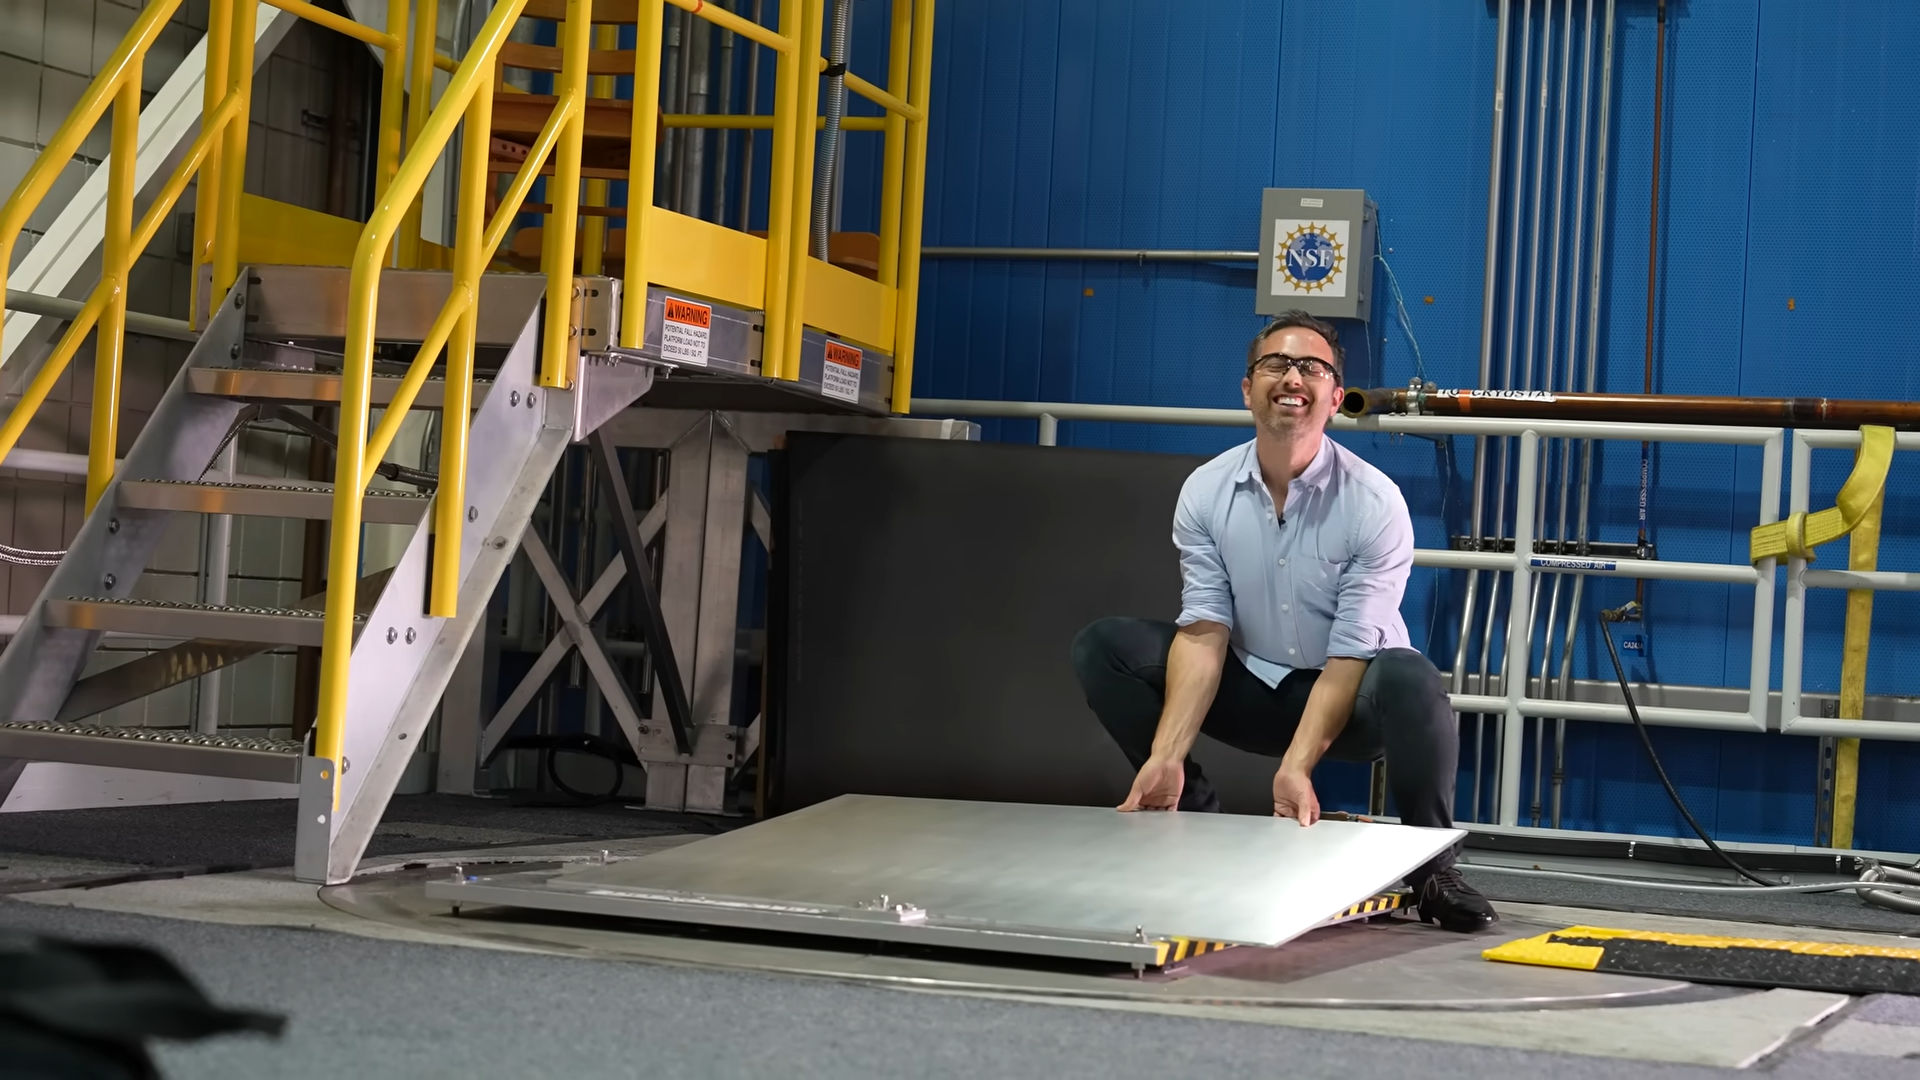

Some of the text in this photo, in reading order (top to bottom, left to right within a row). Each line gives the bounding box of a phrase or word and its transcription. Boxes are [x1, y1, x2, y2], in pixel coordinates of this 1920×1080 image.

[1288, 248, 1333, 267] NSF
[675, 304, 708, 325] WARNING
[665, 324, 684, 334] POTENTIAL
[684, 327, 693, 336] FALL
[664, 334, 683, 344] PLATFORM
[683, 338, 693, 346] LOAD
[663, 344, 678, 354] EXCEED
[833, 347, 859, 366] WARNING
[1472, 389, 1555, 399] CRYOSTA
[1640, 459, 1648, 507] COMPRESSED
[1540, 559, 1591, 568] COMPRESSED
